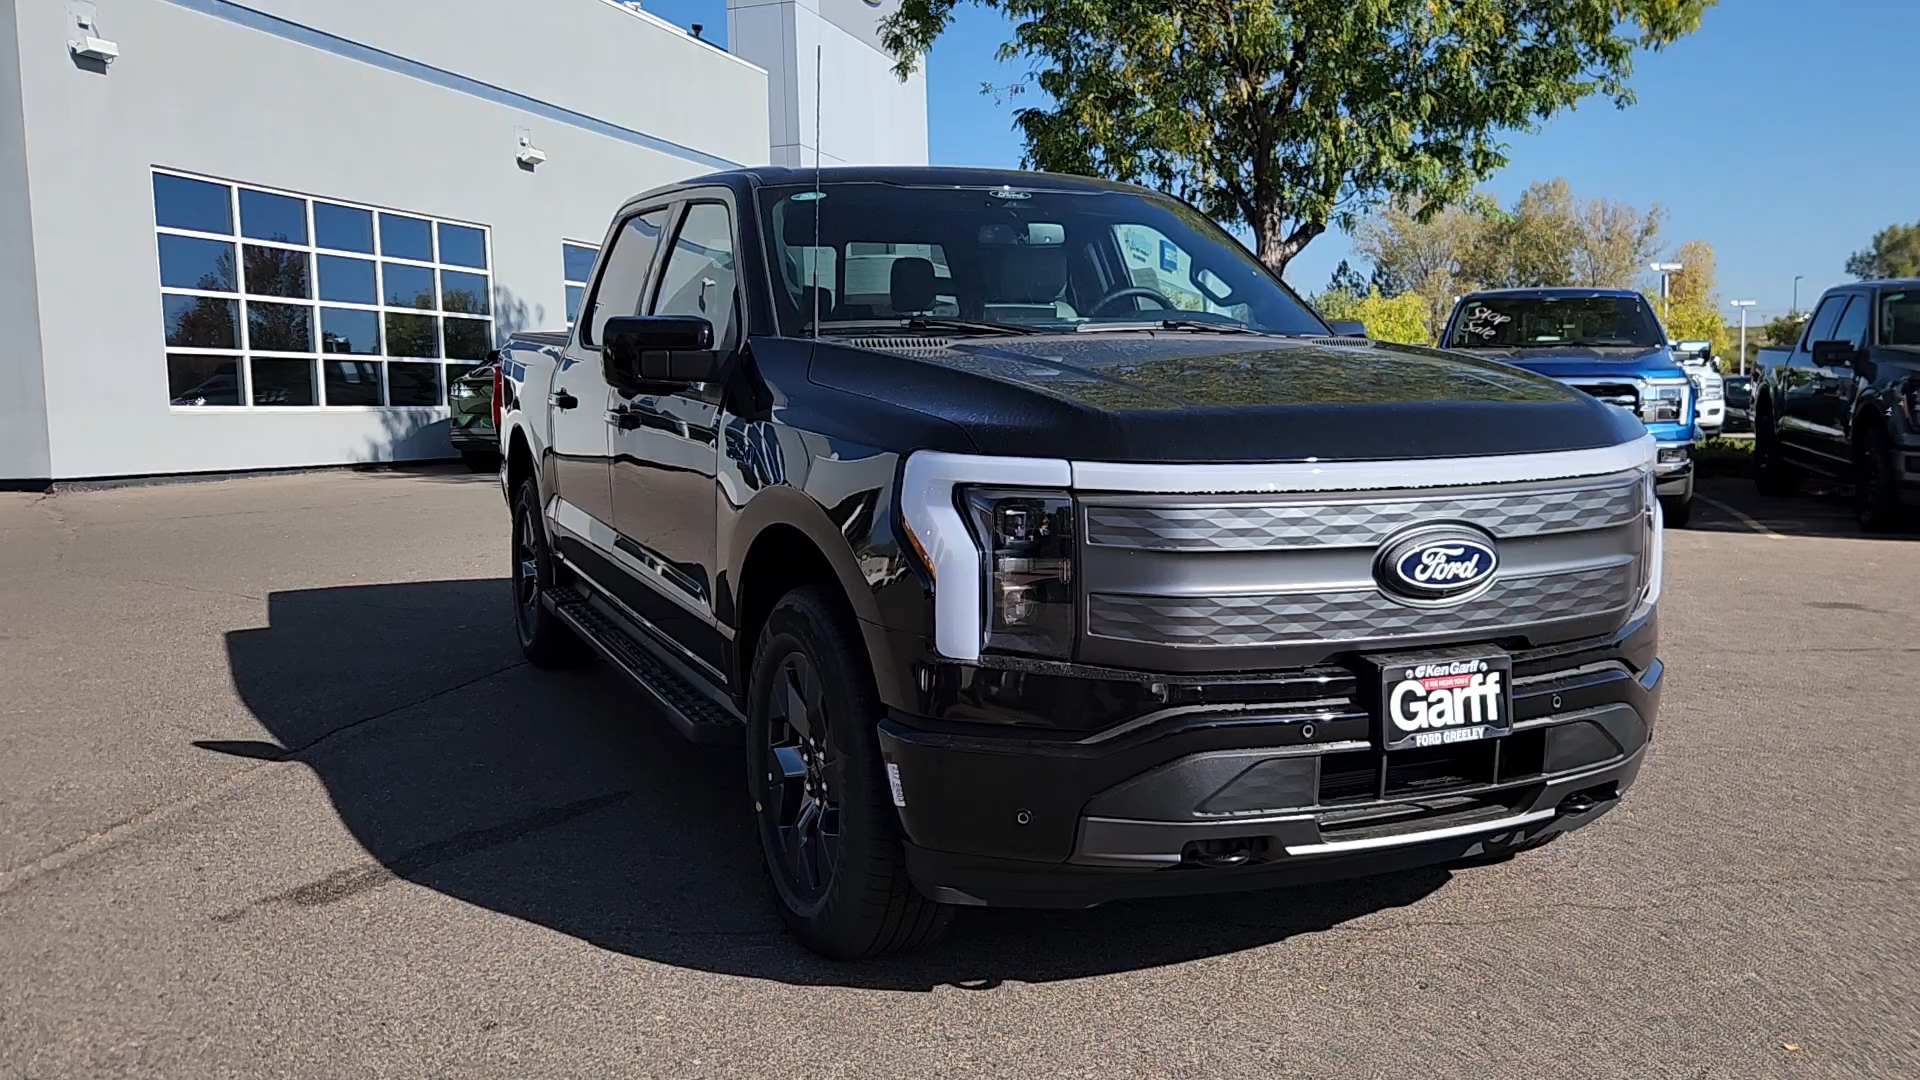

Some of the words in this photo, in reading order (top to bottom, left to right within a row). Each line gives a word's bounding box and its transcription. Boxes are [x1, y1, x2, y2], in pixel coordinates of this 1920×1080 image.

[1414, 547, 1480, 581] Ford
[1425, 665, 1449, 677] Ken
[1450, 660, 1479, 675] Garff
[1390, 672, 1500, 731] Garff
[1416, 732, 1441, 747] FORD
[1443, 727, 1485, 743] GREELEY
